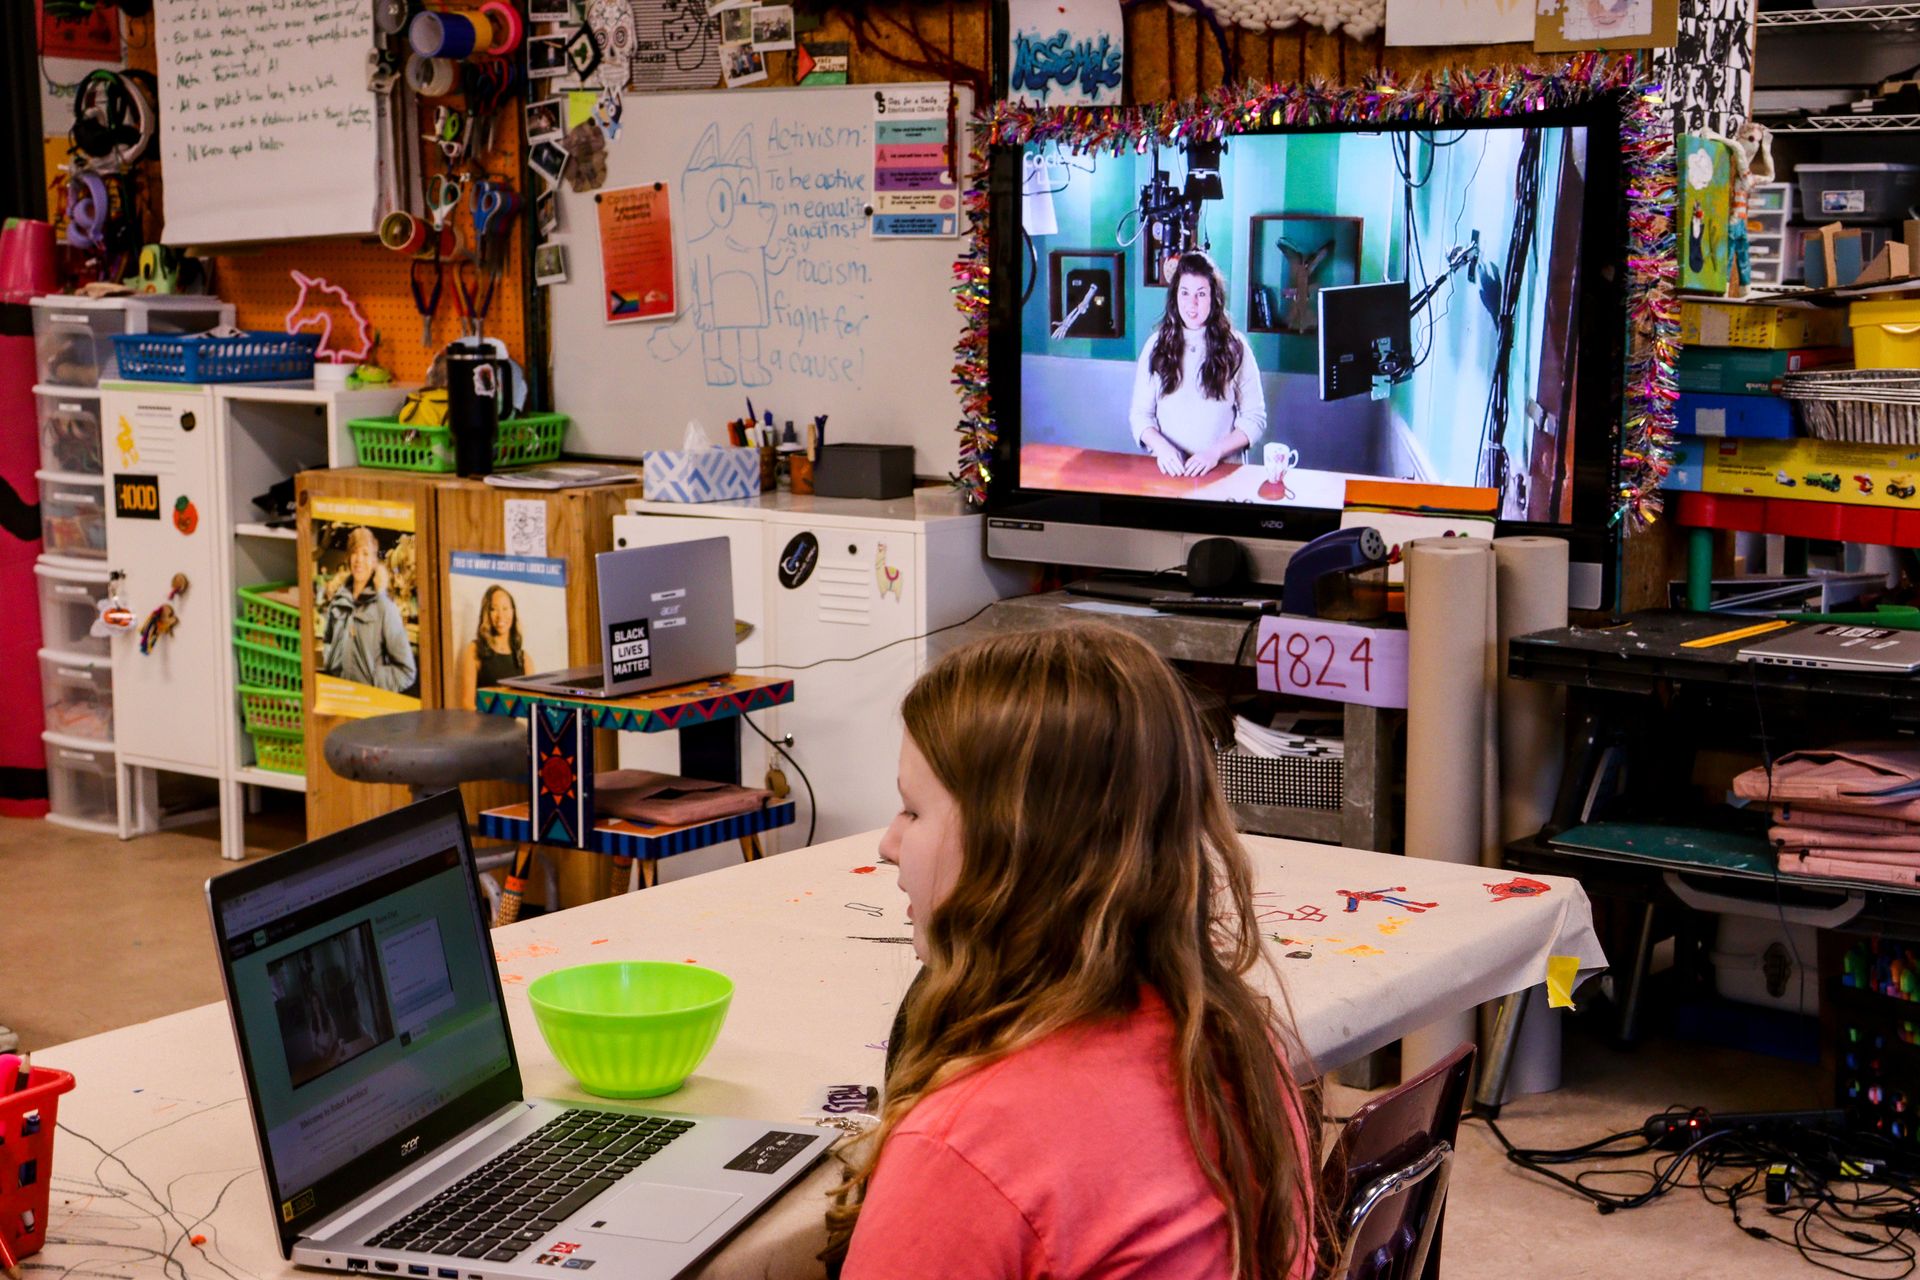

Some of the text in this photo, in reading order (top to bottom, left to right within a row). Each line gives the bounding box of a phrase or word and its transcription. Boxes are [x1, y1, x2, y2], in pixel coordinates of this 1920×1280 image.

[877, 97, 886, 114] 5
[768, 118, 867, 151] Activism:
[765, 168, 785, 191] To
[789, 166, 811, 190] be
[815, 168, 865, 191] active
[614, 627, 645, 643] BLACK
[618, 644, 643, 658] LIVES
[613, 659, 650, 676] MATTER
[1256, 632, 1373, 693] 4824
